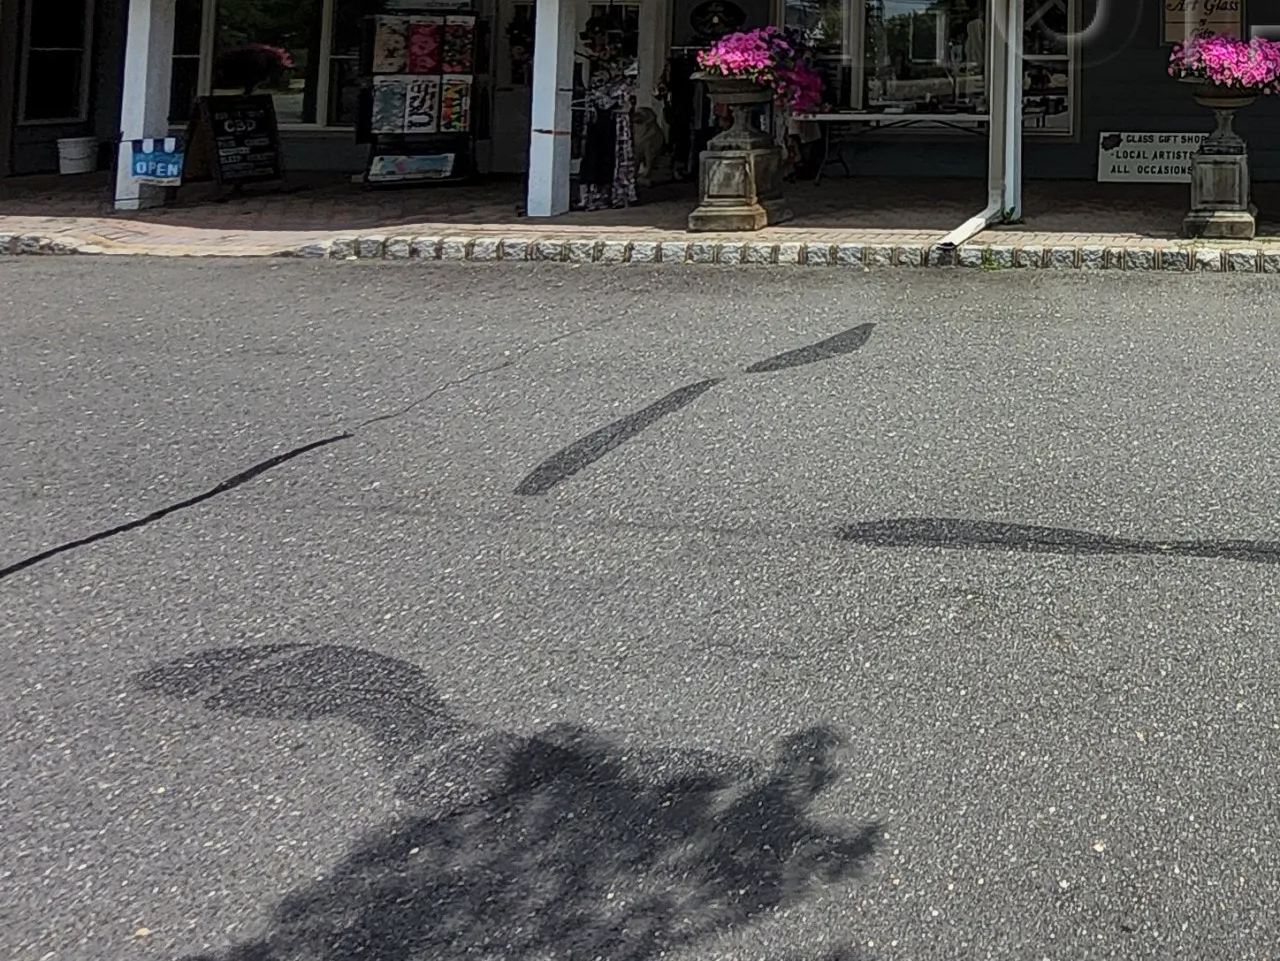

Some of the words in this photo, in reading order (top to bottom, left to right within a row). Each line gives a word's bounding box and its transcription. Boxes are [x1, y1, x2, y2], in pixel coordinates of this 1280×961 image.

[224, 120, 256, 132] CBD
[1126, 135, 1154, 143] GLASS
[1159, 135, 1178, 144] GIFT
[1152, 150, 1194, 160] ARTISTS
[136, 161, 178, 176] OPEN
[1111, 165, 1130, 174] ALL
[1137, 165, 1193, 175] OCCASIONS
